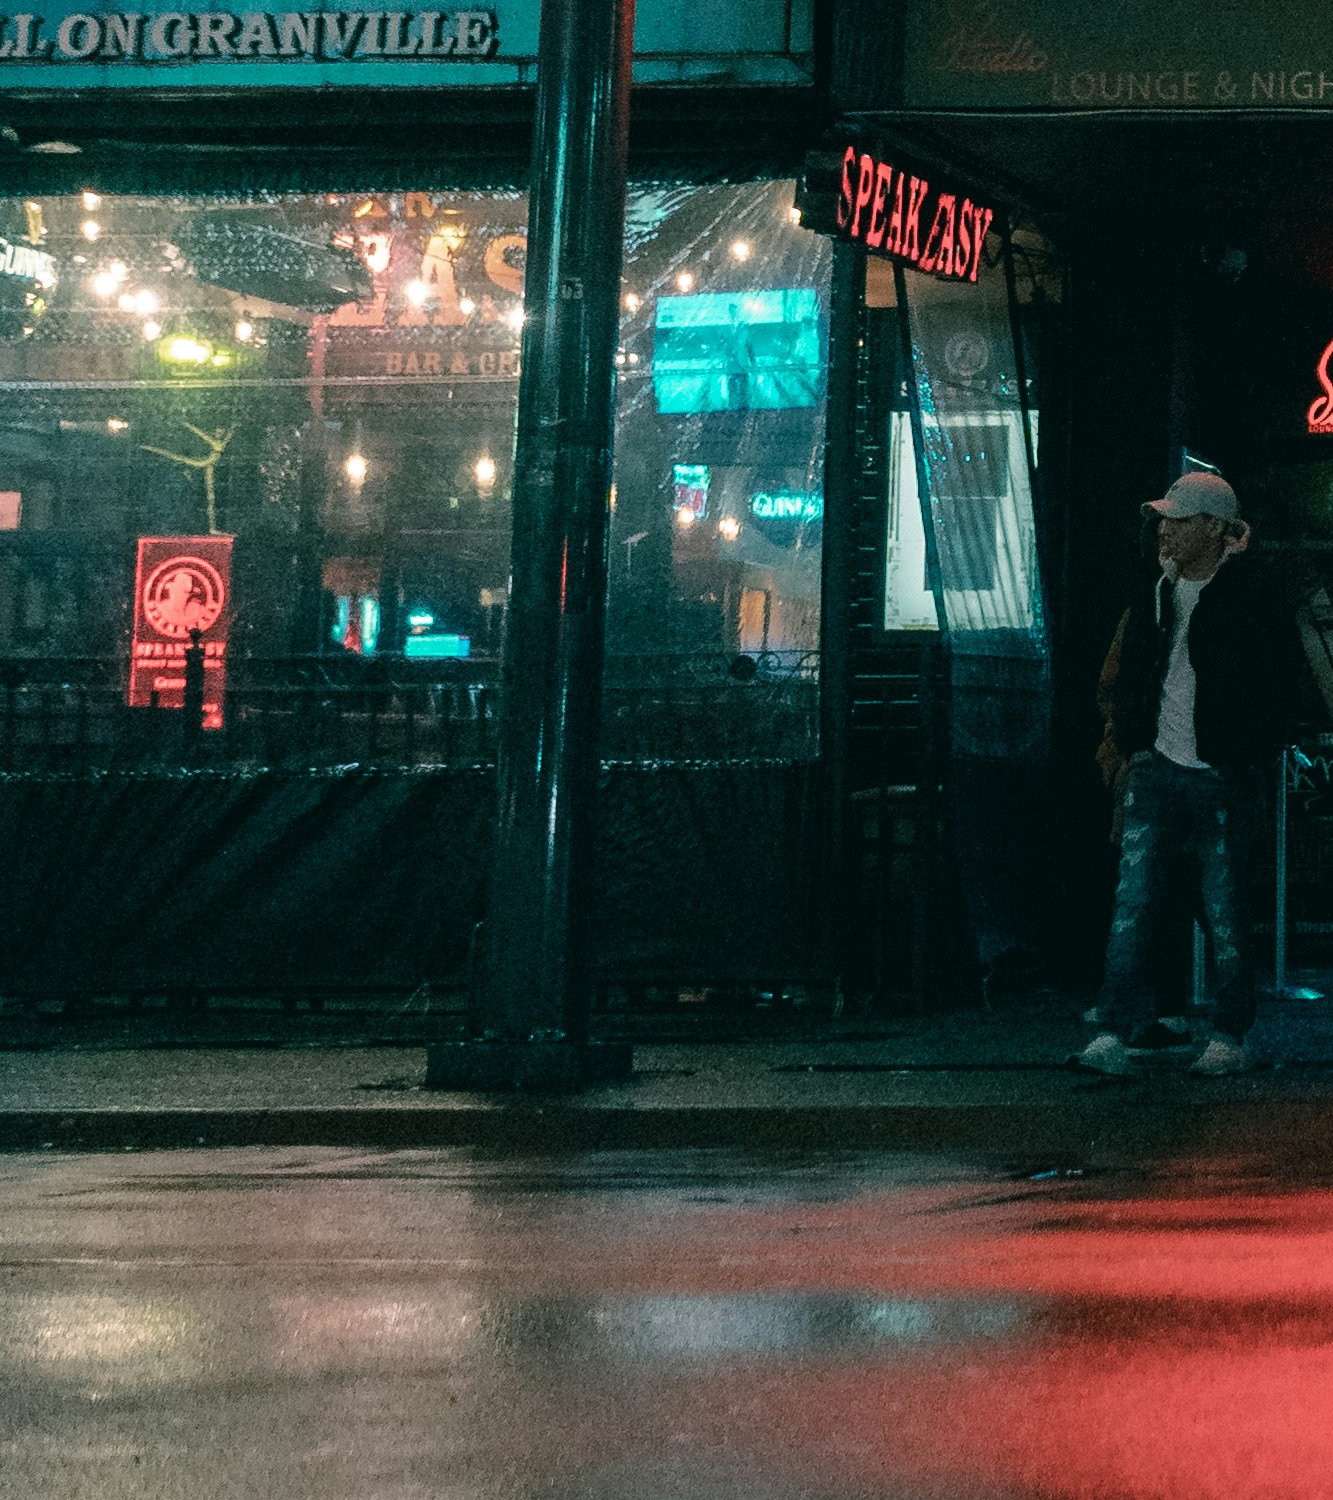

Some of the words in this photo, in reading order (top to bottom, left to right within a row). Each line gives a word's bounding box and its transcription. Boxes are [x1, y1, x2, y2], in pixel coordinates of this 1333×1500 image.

[57, 12, 140, 57] ON
[150, 10, 495, 57] GRANVILLE
[1052, 70, 1202, 101] LOUNGE
[1215, 70, 1237, 101] &
[385, 351, 440, 376] BAR
[448, 351, 469, 376] &
